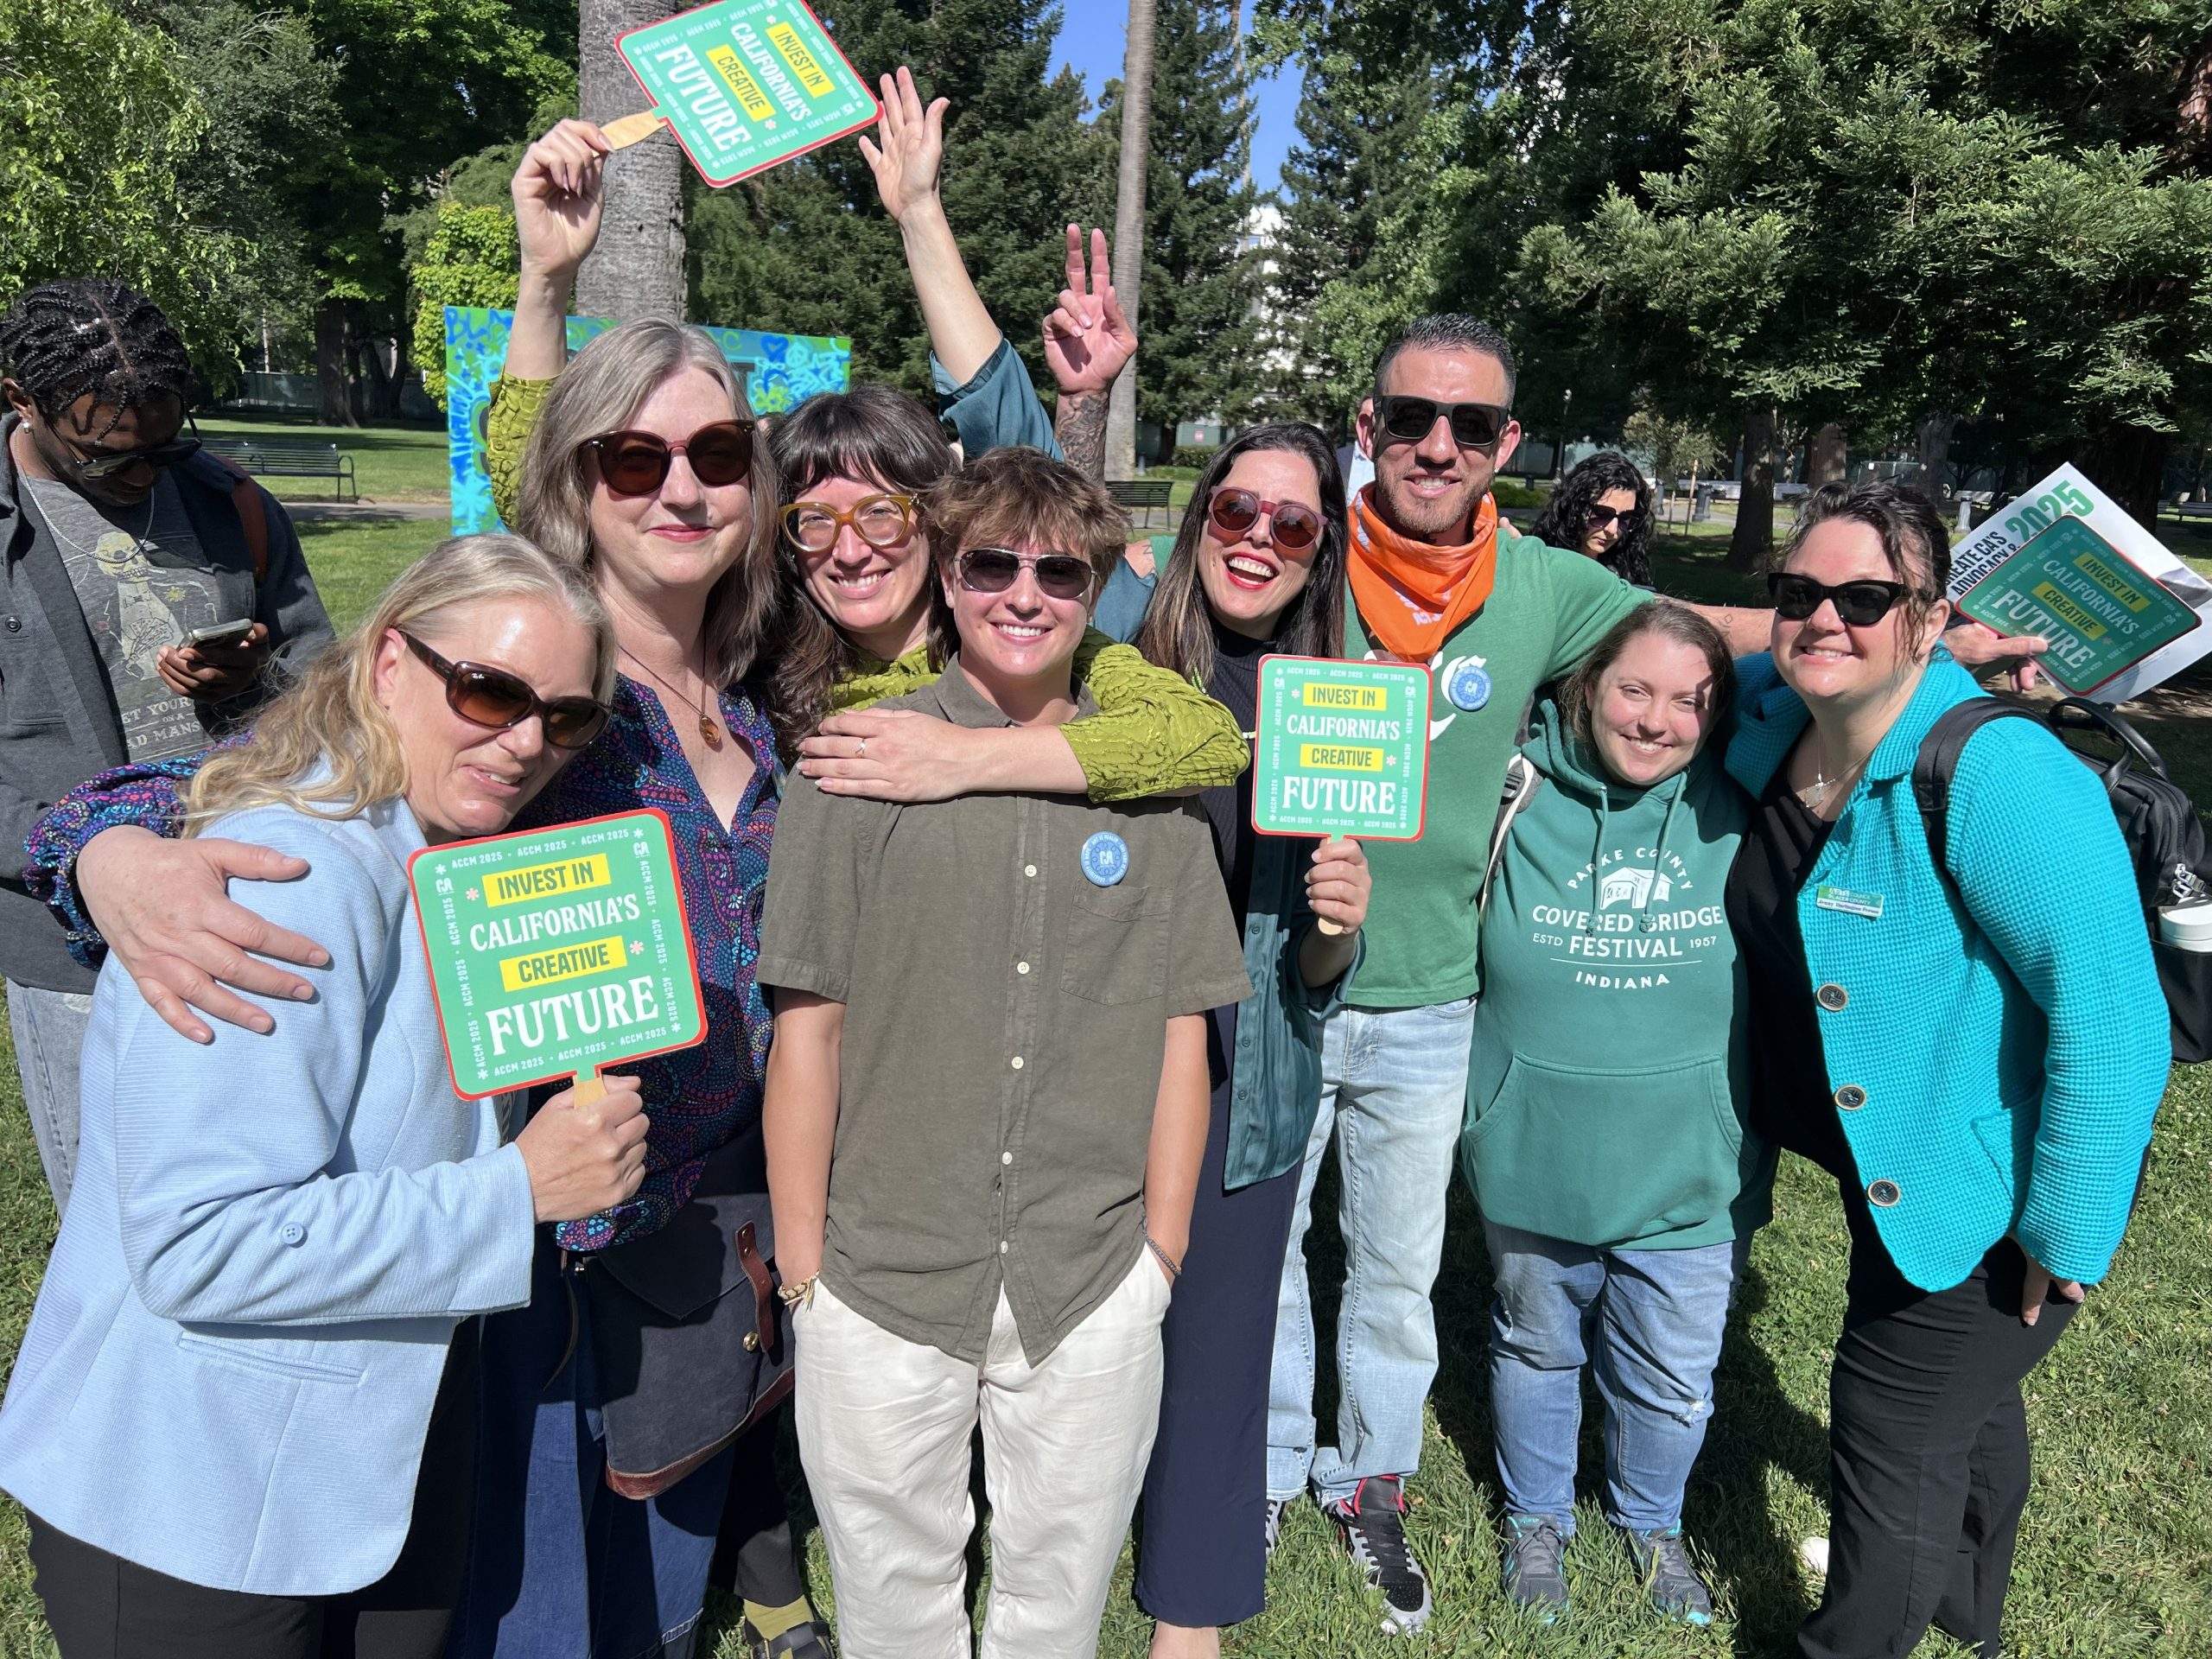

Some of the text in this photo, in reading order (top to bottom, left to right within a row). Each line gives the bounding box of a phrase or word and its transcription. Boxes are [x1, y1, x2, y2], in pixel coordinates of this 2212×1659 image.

[727, 21, 813, 122] CALIFORNIA'S
[774, 30, 815, 73] INVEST
[803, 71, 825, 87] IN
[653, 42, 753, 152] FUTURE
[716, 55, 766, 110] CREATIVE
[2005, 480, 2094, 542] 2025
[1974, 531, 2007, 556] CA'S
[2040, 557, 2141, 635] CALIFORNIA'S
[2081, 558, 2127, 594] INVEST
[2120, 589, 2141, 604] IN
[1989, 588, 2098, 669] FUTURE
[2040, 589, 2098, 632] CREATIVE
[121, 696, 191, 724] ET YOUR
[1312, 686, 1375, 706] INVEST IN
[127, 721, 200, 749] AD MANS
[162, 715, 174, 723] ON
[1286, 714, 1400, 740] CALIFORNIA'S
[1311, 748, 1372, 767] CREATIVE
[1282, 776, 1396, 814] FUTURE
[451, 828, 629, 869] ACCM 2025 ACCM 2025 ACCM 2025
[496, 860, 594, 900] INVEST IN
[467, 892, 641, 953] CALIFORNIA'S
[638, 859, 679, 1022] ACCM 2025 ACCM 2025 ACCM 2025
[517, 943, 610, 983] CREATIVE
[1533, 933, 1717, 958] ESTD FESTIVAL 1957
[441, 897, 486, 1067] ACCM 2025 ACCM 2025 ACCM 2025
[1576, 971, 1670, 989] INDIANA
[484, 974, 660, 1056] FUTURE
[493, 1026, 666, 1076] ACCM 2025 ACCM 2025 ACCM 2025
